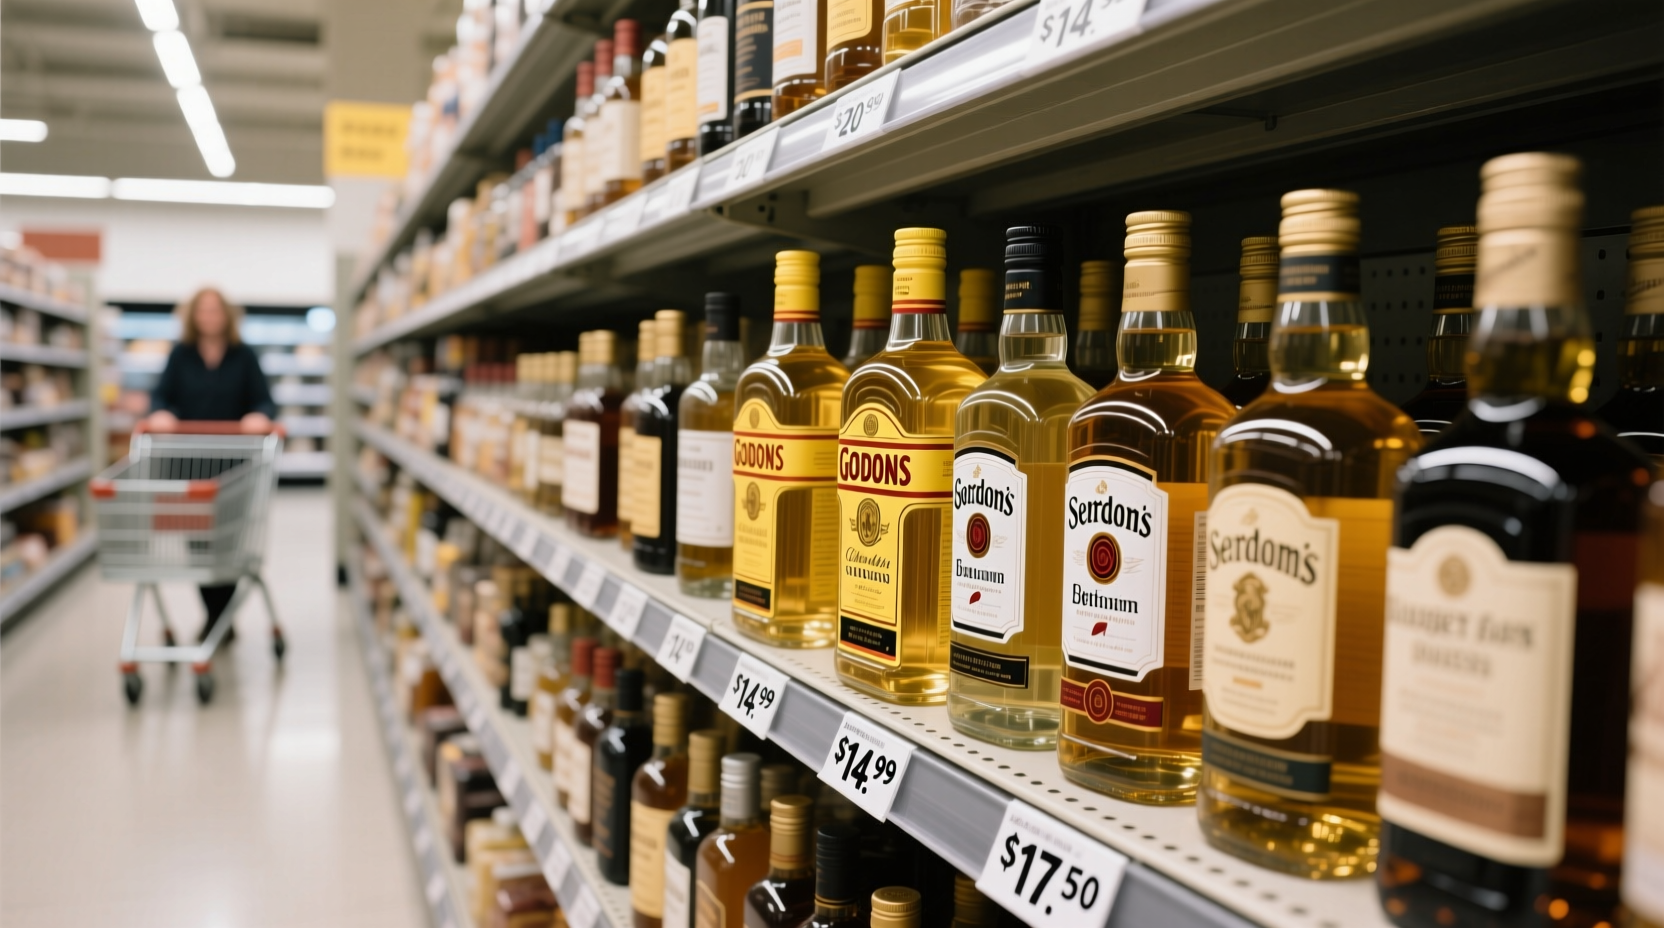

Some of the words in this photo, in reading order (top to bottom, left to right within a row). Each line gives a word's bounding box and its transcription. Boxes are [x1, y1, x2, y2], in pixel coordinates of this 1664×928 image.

[734, 438, 784, 471] GODONS
[839, 446, 912, 487] GODONS
[732, 673, 776, 719] $14.99
[834, 735, 897, 794] $14.99
[1000, 832, 1100, 915] $17.50
